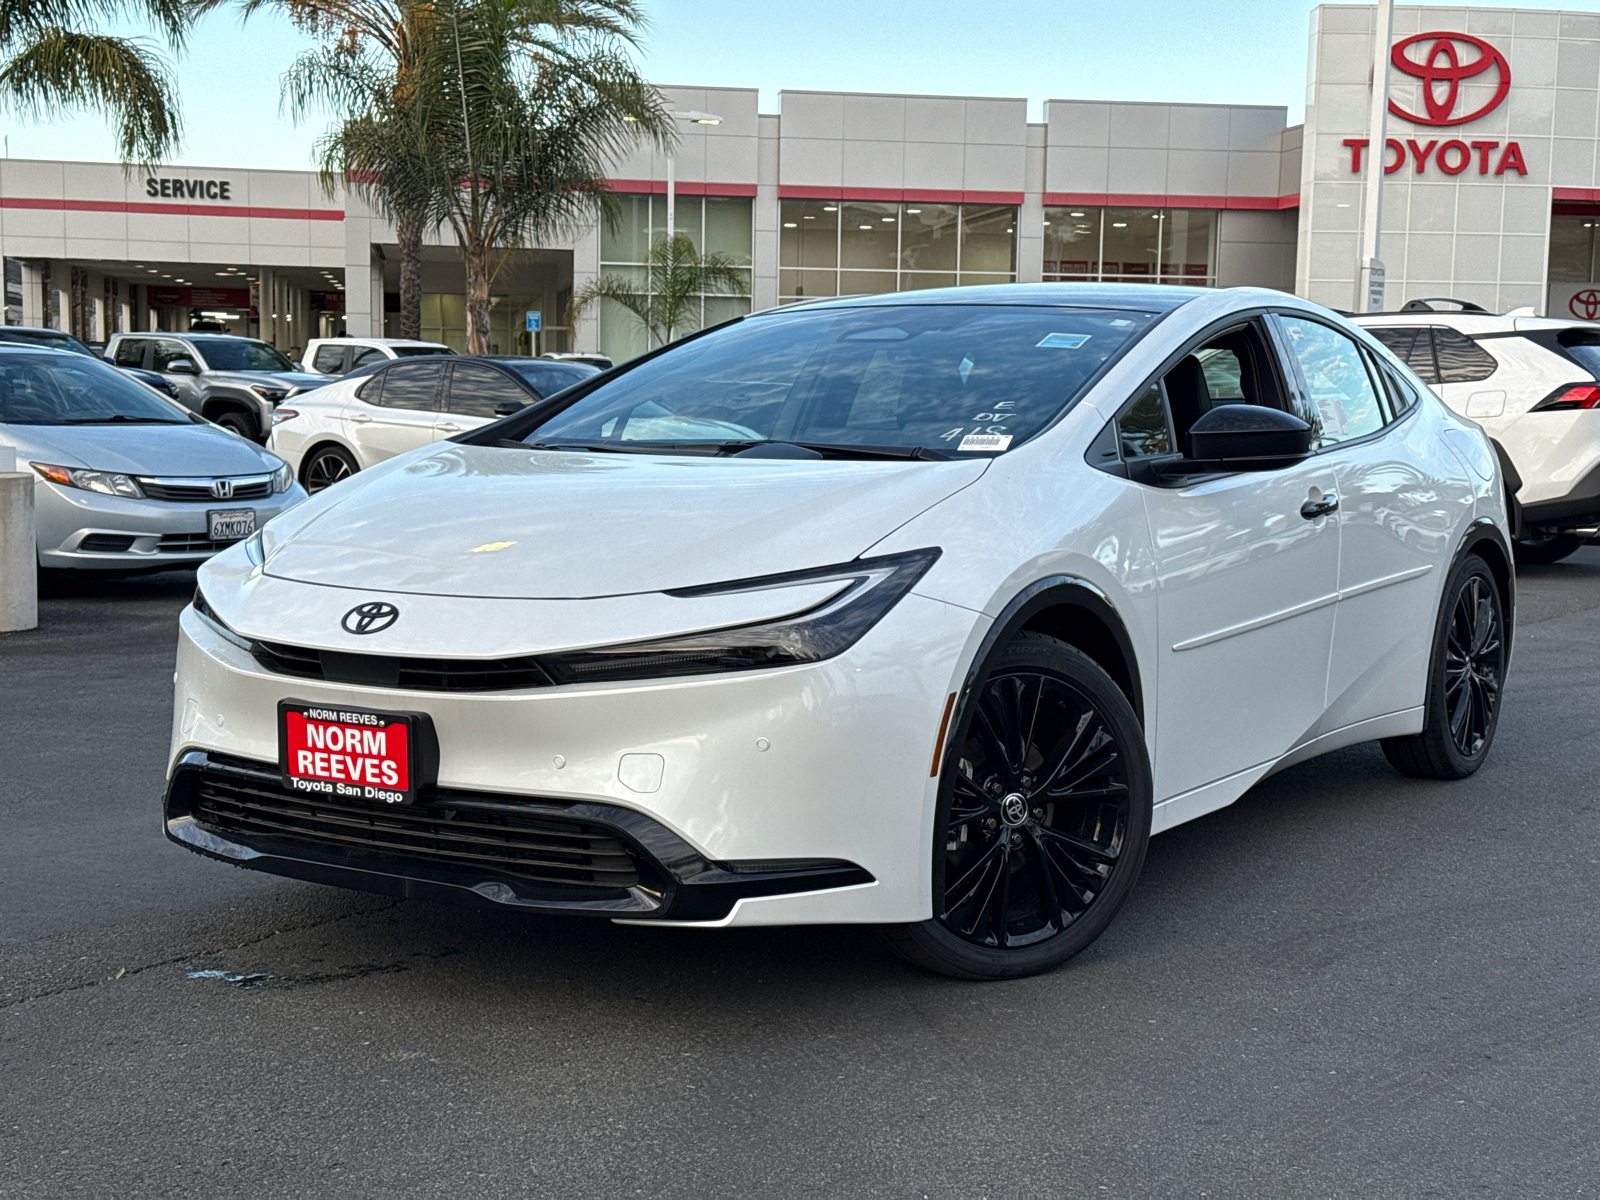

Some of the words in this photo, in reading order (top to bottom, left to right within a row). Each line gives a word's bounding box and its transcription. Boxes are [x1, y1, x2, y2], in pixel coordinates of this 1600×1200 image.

[1343, 138, 1528, 176] TOYOTA
[146, 177, 231, 200] SERVICE
[213, 520, 253, 536] 6XMK076
[309, 708, 338, 721] NORM
[339, 711, 378, 726] REEVES
[306, 723, 387, 757] NORM
[297, 749, 399, 786] REEVES
[290, 776, 333, 792] Toyota
[336, 782, 361, 797] San
[364, 786, 403, 803] Diego
